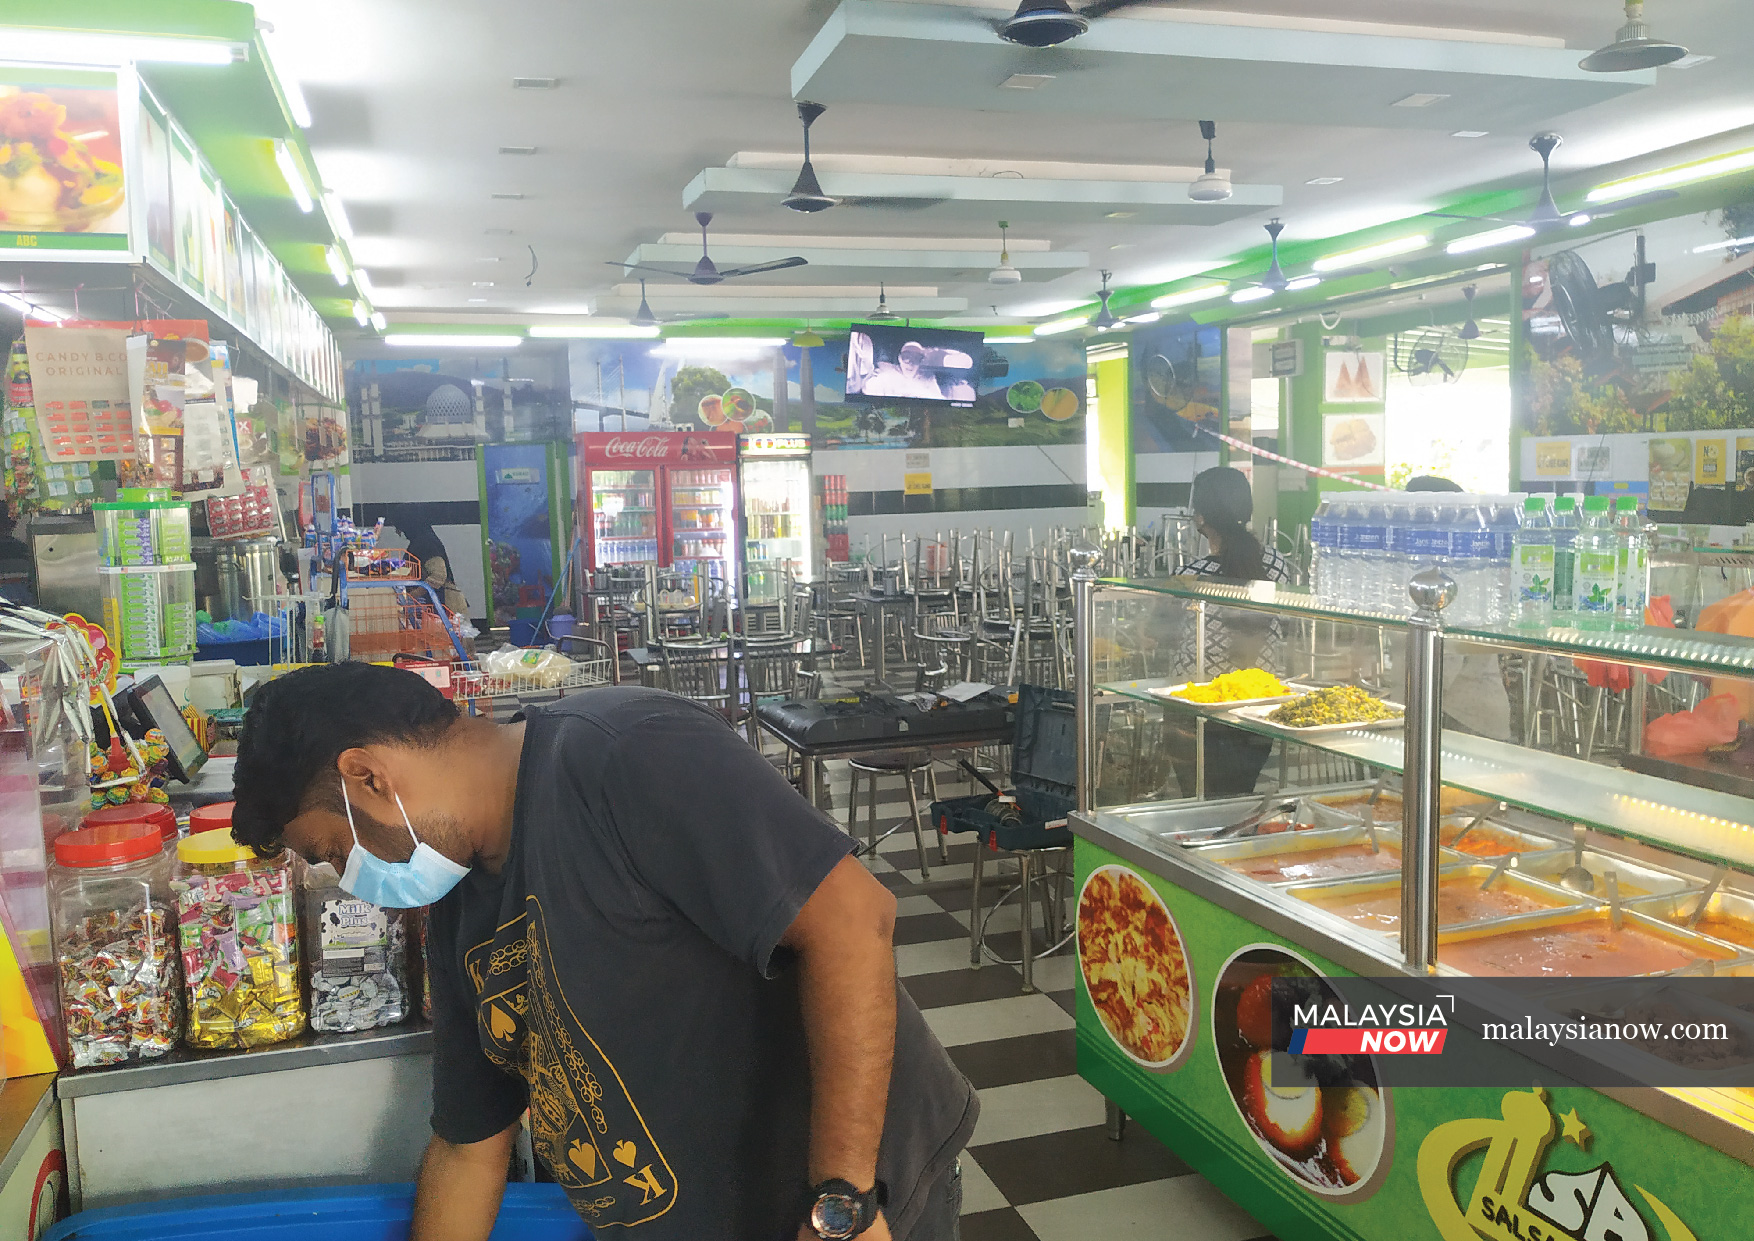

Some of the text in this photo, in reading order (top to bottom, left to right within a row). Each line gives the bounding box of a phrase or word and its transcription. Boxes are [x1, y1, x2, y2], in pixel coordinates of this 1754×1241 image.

[16, 234, 38, 247] ABC
[35, 352, 89, 362] CANDY
[45, 366, 123, 377] ORIGINAL
[605, 436, 672, 458] Coca-Cola
[338, 903, 372, 915] Milk
[341, 915, 369, 928] Plus
[623, 1163, 667, 1206] K
[1481, 1195, 1556, 1241] SALS
